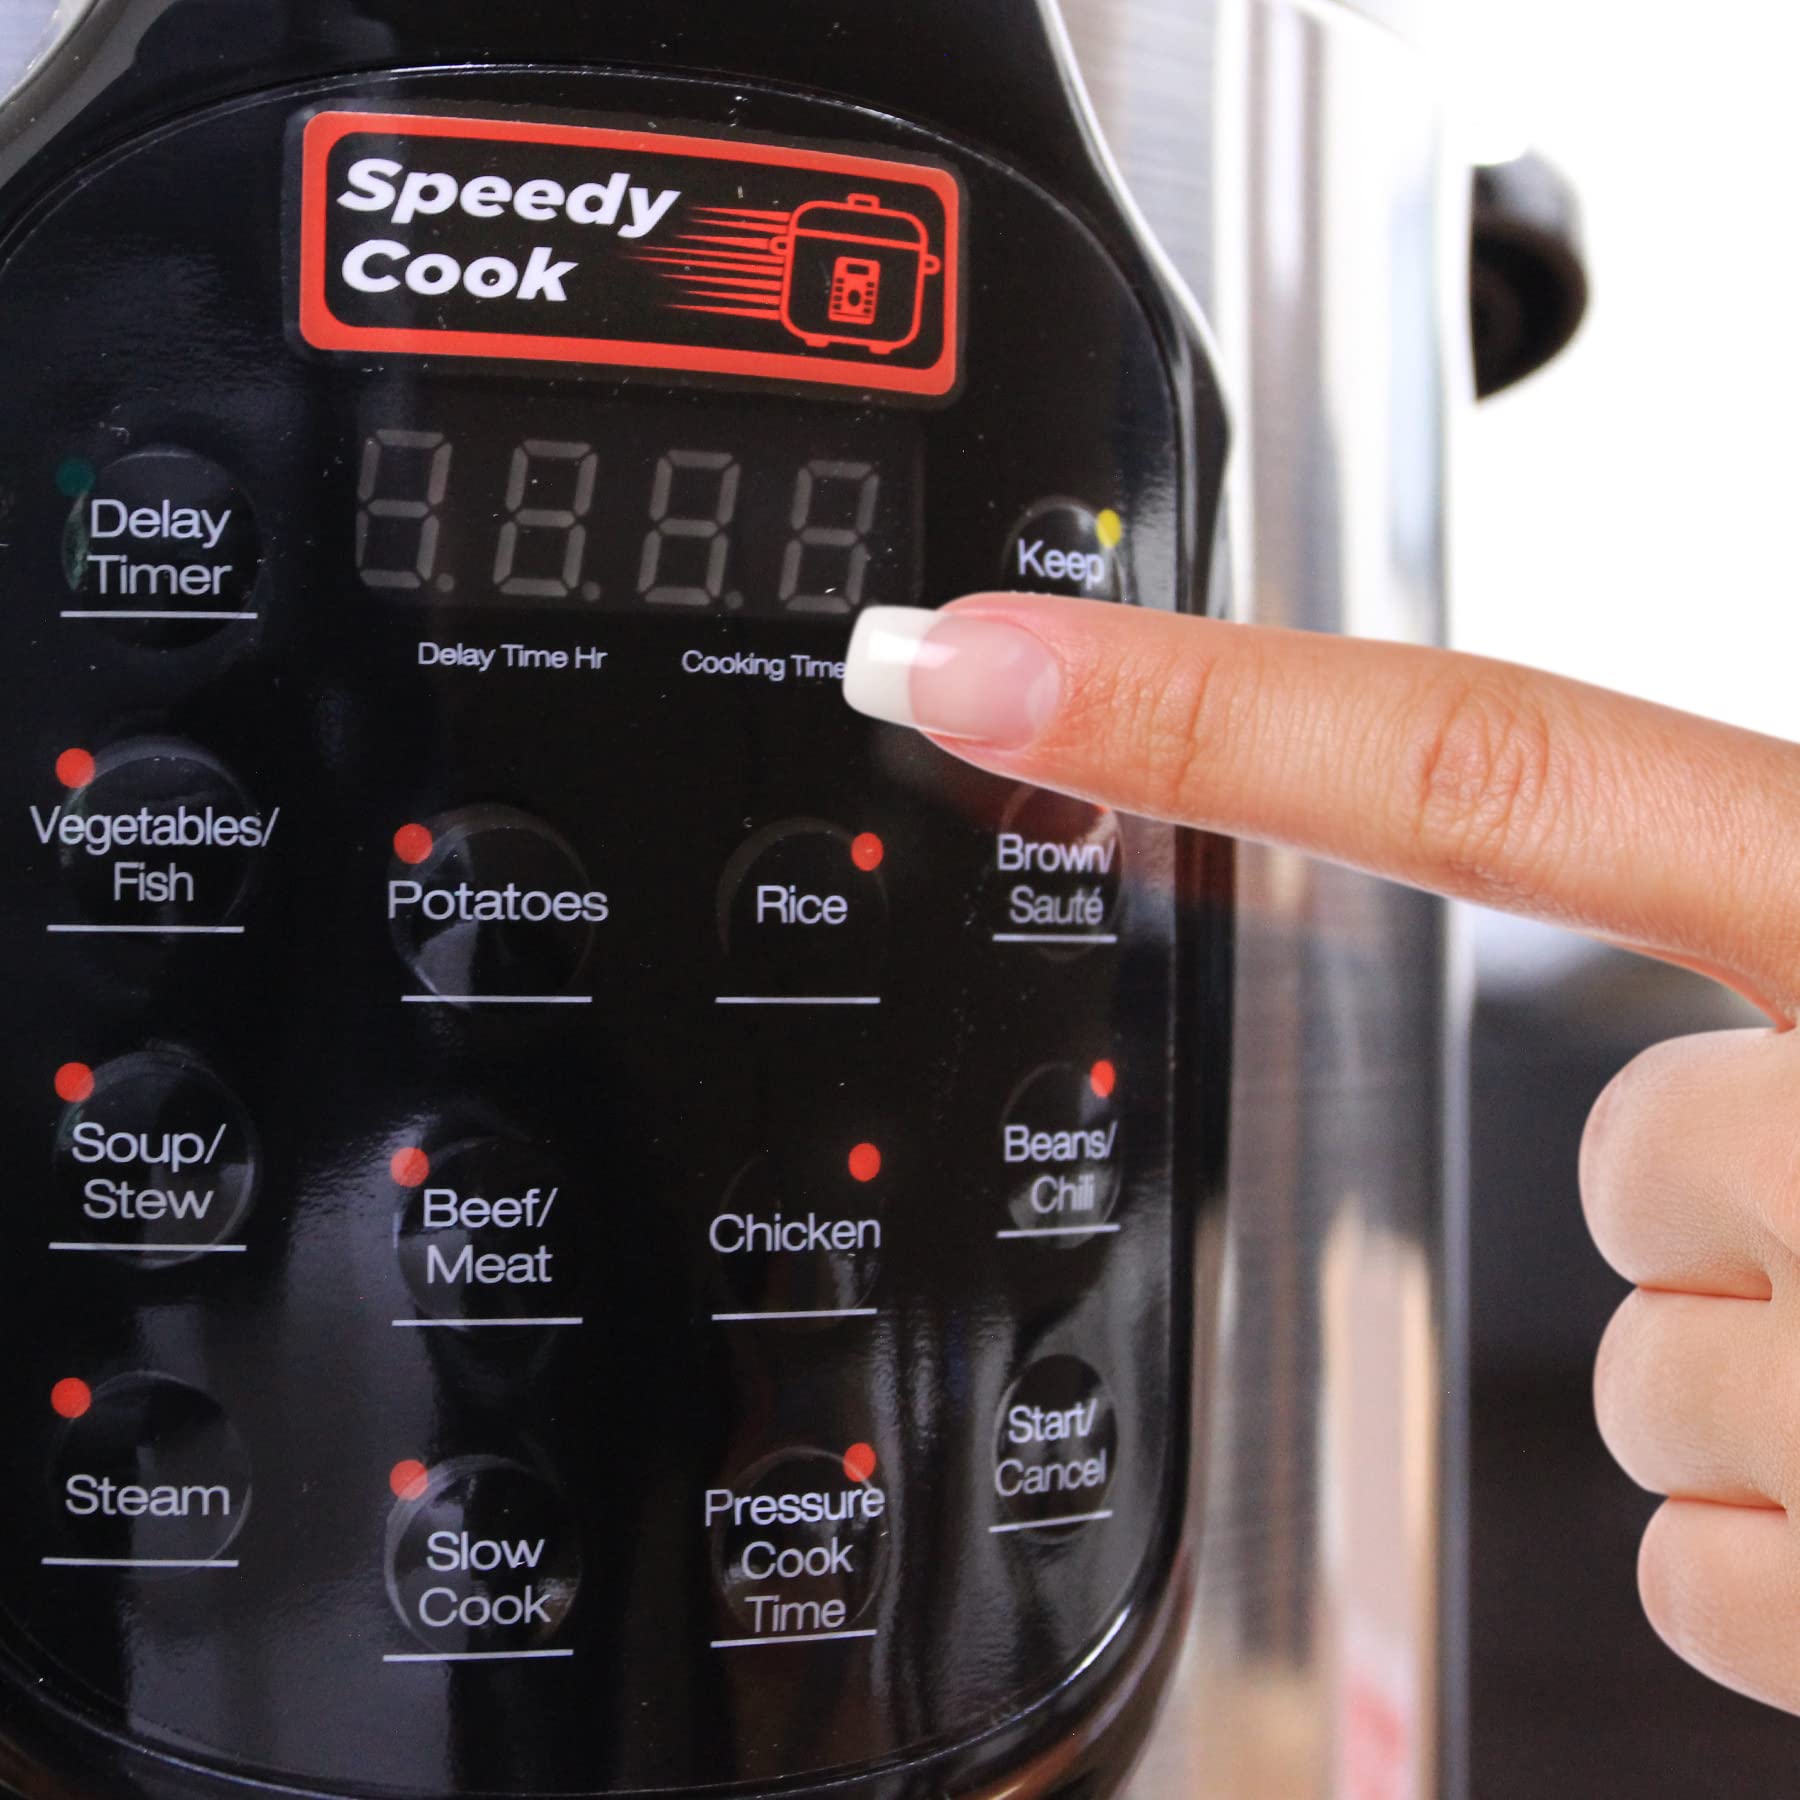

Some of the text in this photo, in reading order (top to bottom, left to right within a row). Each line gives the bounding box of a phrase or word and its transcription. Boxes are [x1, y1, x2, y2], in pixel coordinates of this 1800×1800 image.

[336, 157, 682, 238] Speedy
[341, 238, 579, 302] Cook
[90, 499, 232, 548] Delay
[88, 555, 233, 596] Timer
[1017, 538, 1105, 591] Keep
[417, 642, 606, 672] Delay Time Hr
[681, 649, 848, 682] Cooking Time
[29, 806, 281, 855] Vegetables/
[997, 833, 1116, 874] Brown/
[113, 862, 195, 902] Fish
[388, 880, 608, 922] Potatoes
[756, 885, 848, 925] Rice
[1009, 886, 1104, 926] Sauté
[70, 1122, 227, 1173] Soup/
[1004, 1121, 1118, 1164] Beans/
[82, 1178, 214, 1220] Stew
[422, 1187, 559, 1229] Beef/
[1029, 1174, 1096, 1214] Chili
[709, 1213, 882, 1254] Chicken
[426, 1245, 553, 1285] Meat
[1007, 1398, 1098, 1445] Start/
[994, 1448, 1107, 1497] Cancel
[65, 1474, 231, 1516] Steam
[704, 1485, 886, 1527] Pressure
[426, 1531, 546, 1572] Slow
[740, 1536, 855, 1581] Cook
[418, 1586, 551, 1629] Cook
[744, 1594, 847, 1635] Time
